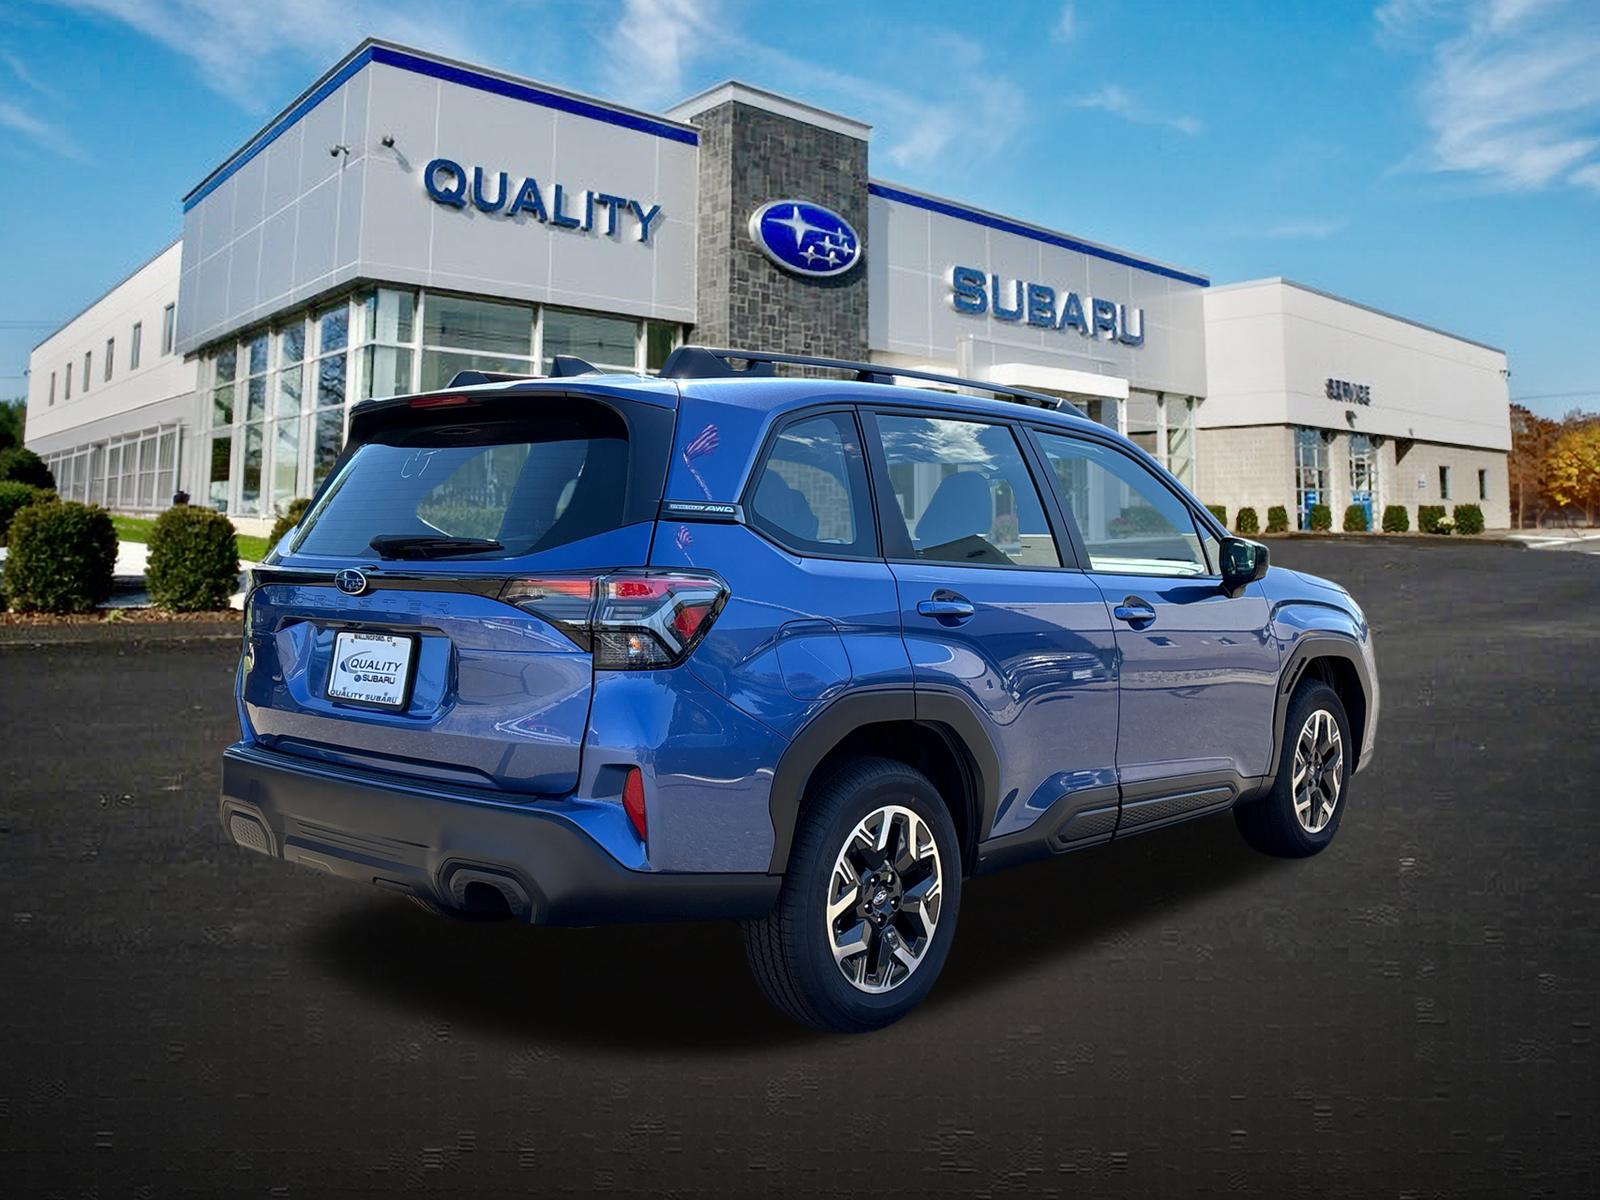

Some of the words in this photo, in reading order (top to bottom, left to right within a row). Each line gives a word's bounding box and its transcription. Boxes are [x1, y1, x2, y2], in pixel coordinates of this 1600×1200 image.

[424, 158, 661, 242] QUALITY
[951, 265, 1145, 346] SUBARU
[1325, 378, 1370, 406] SERVICE
[705, 505, 734, 513] AWD
[350, 658, 402, 672] QUALITY
[362, 674, 395, 684] SUBARU
[330, 689, 363, 699] QUALITY
[364, 693, 397, 703] SUBARU
